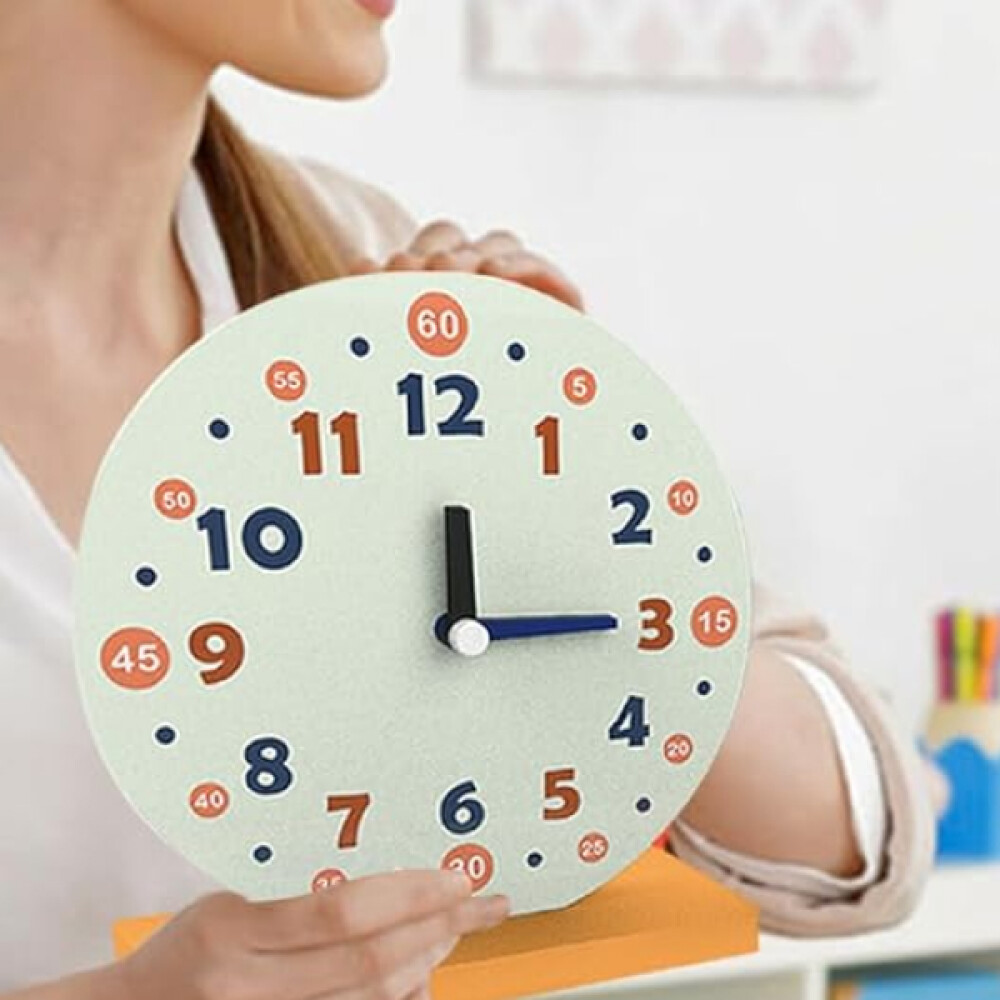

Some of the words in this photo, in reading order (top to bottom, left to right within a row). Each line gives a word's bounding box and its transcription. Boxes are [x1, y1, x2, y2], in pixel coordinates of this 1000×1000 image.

[417, 310, 459, 339] 60
[273, 371, 300, 389] 55
[397, 373, 485, 436] 12
[572, 378, 588, 397] 5
[291, 411, 361, 475] 11
[534, 415, 560, 475] 1
[163, 491, 191, 510] 50
[610, 489, 652, 545] 2
[672, 489, 694, 507] 10
[197, 507, 303, 570] 10
[638, 598, 675, 650] 3
[699, 610, 731, 633] 15
[111, 644, 161, 673] 45
[189, 621, 245, 685] 9
[608, 695, 650, 747] 4
[244, 737, 293, 796] 8
[667, 741, 690, 757] 20
[194, 790, 225, 807] 40
[440, 780, 486, 834] 6
[543, 768, 581, 821] 5
[326, 793, 371, 849] 7
[582, 840, 606, 856] 25
